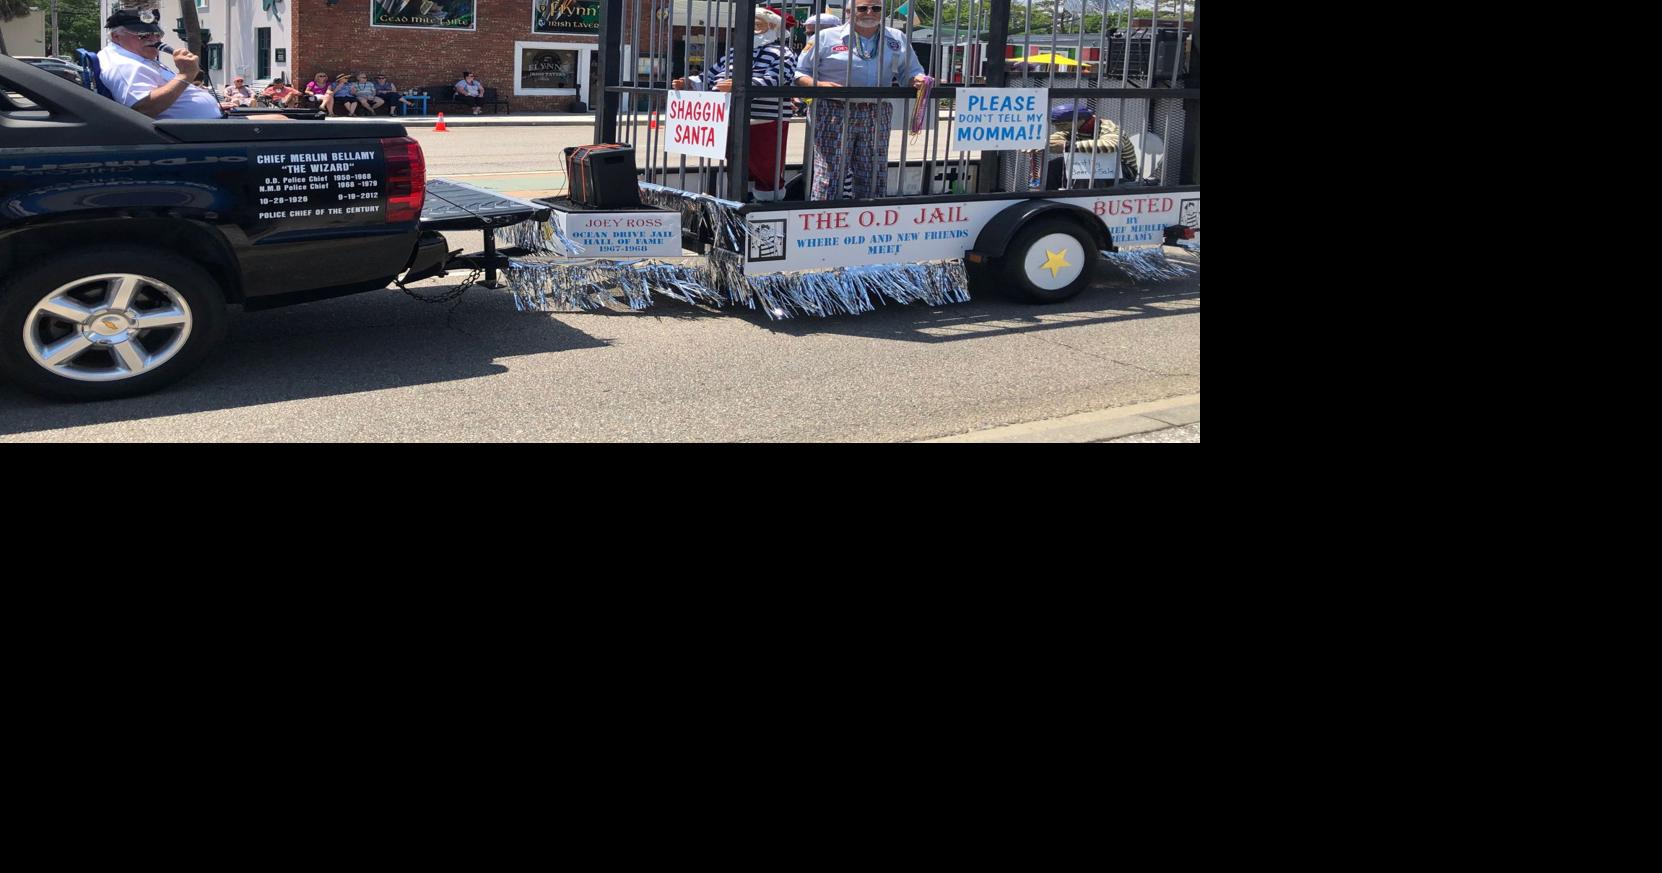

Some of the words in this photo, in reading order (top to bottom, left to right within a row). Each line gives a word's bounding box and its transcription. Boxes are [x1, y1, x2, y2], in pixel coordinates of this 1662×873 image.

[551, 1, 600, 17] Flynn'
[573, 21, 600, 29] TAVER
[968, 95, 1036, 112] PLEASE
[669, 100, 726, 123] SHAGGIN
[958, 113, 994, 123] DON'T
[998, 113, 1022, 123] TELL
[1026, 113, 1043, 122] MY
[674, 124, 715, 147] SANTA
[957, 124, 1043, 142] MOMMA!!
[257, 154, 286, 164] CHIEF
[290, 153, 328, 162] MERLIN
[331, 151, 375, 161] BELLAMY
[281, 164, 306, 173] "THE
[259, 211, 286, 219] POLICE
[289, 209, 312, 217] CHIEF
[315, 208, 326, 216] OF
[346, 205, 380, 214] CENTURY
[1093, 198, 1174, 216] BUSTED
[585, 218, 622, 227] JOEY
[626, 218, 663, 227] ROSS
[798, 211, 849, 230] THE
[858, 209, 899, 228] O.D
[913, 206, 969, 225] JAIL
[1126, 216, 1138, 225] BY
[1108, 226, 1127, 234] IEF
[796, 236, 840, 249] WHERE
[843, 235, 865, 246] OLD
[869, 233, 893, 244] AND
[898, 231, 920, 242] NEW
[924, 229, 969, 240] FRIENDS
[867, 244, 903, 255] MEET
